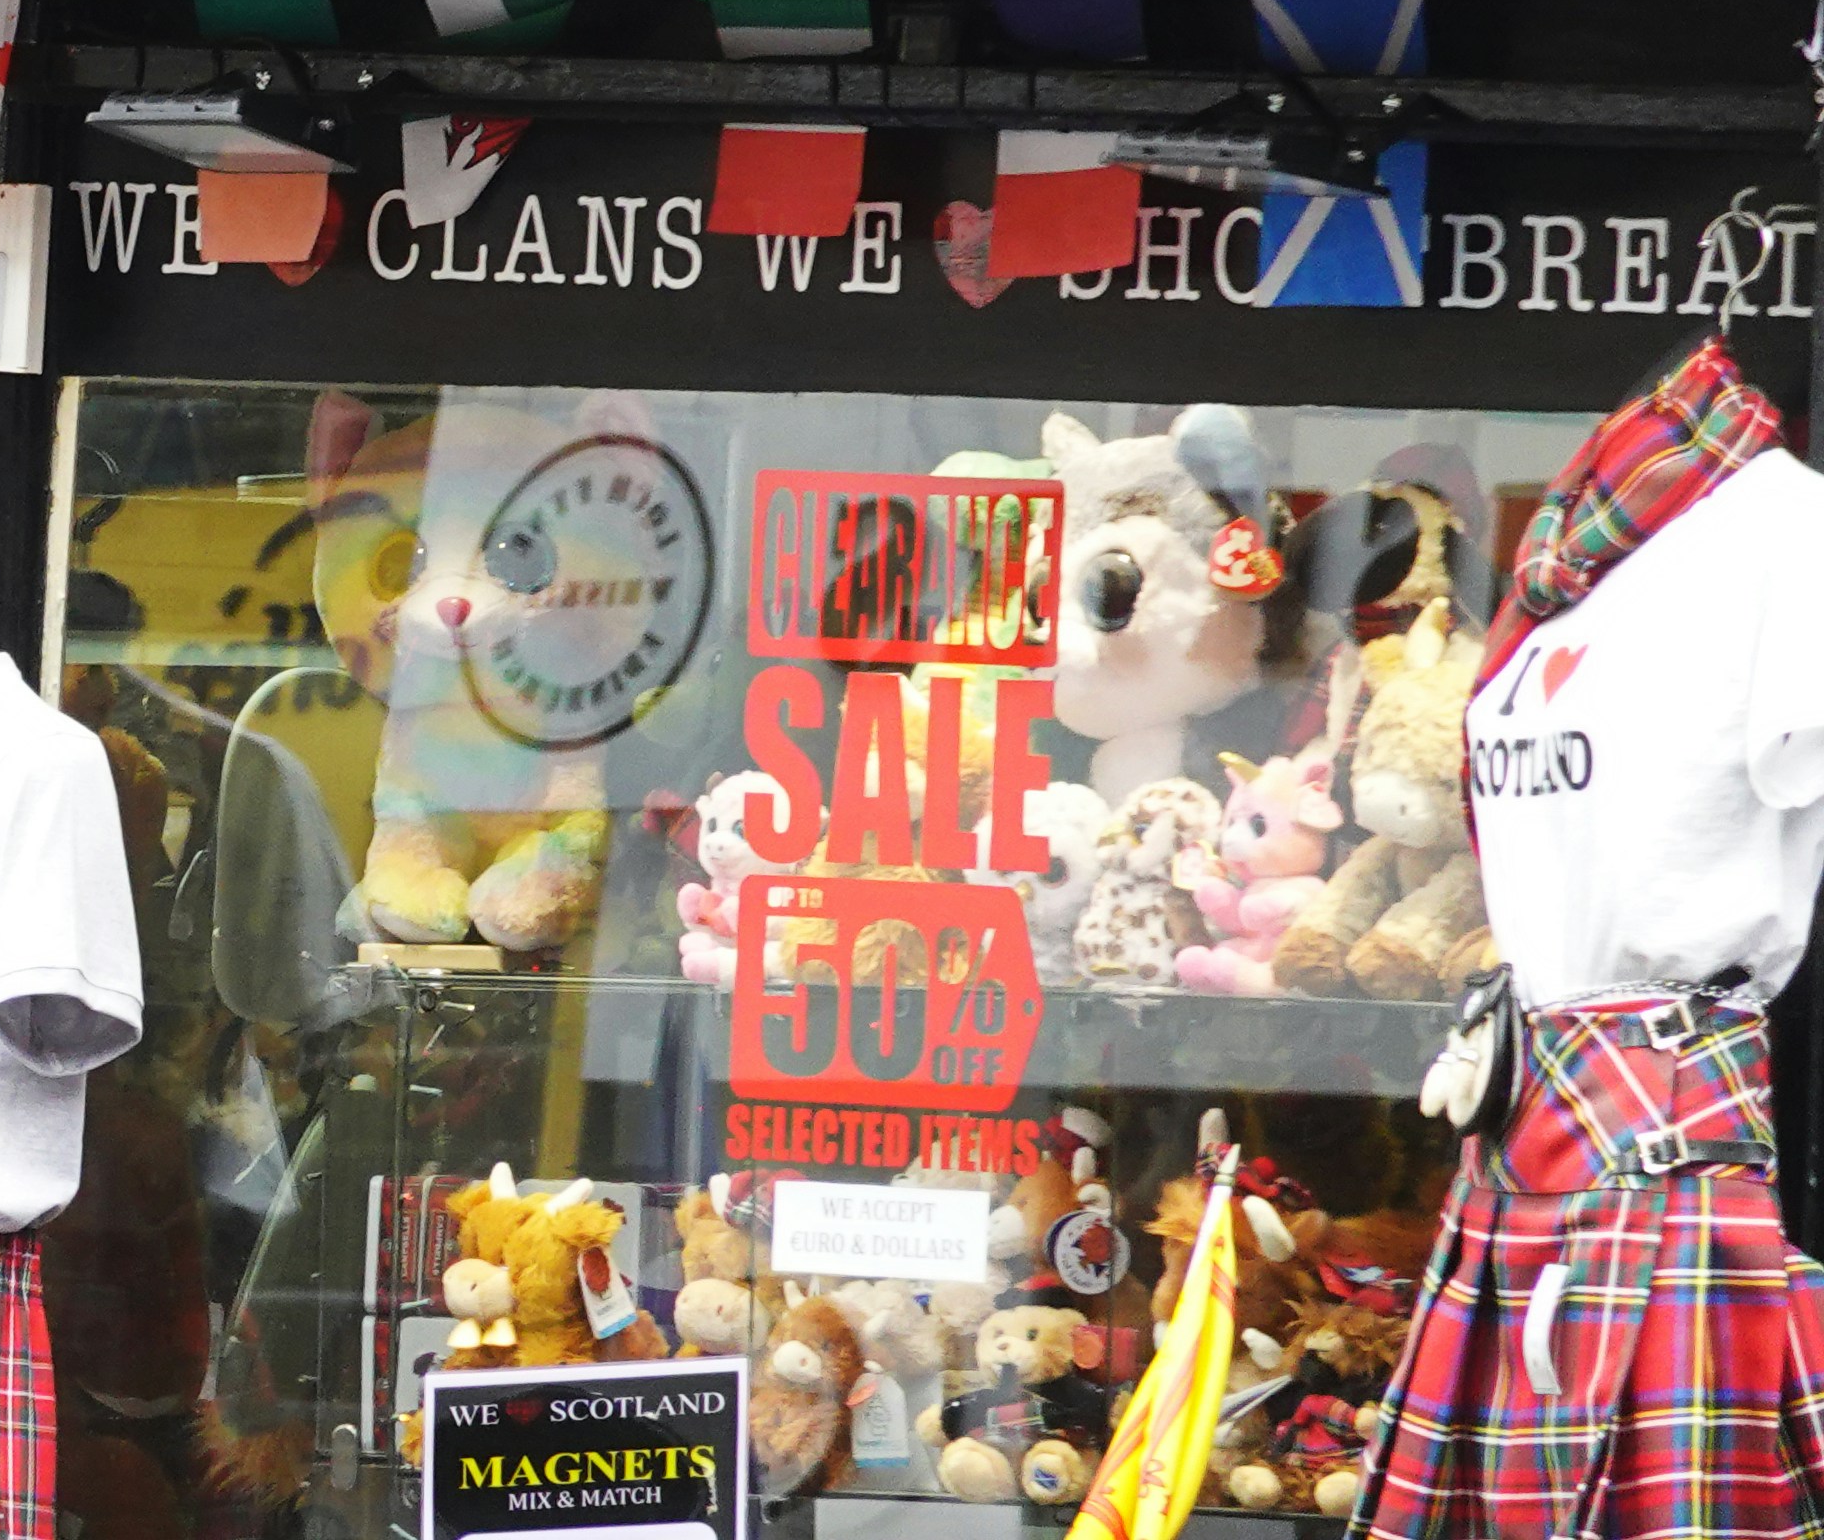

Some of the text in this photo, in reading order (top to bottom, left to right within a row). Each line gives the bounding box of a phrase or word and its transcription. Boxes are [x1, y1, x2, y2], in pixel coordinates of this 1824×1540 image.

[68, 182, 219, 276] WE
[366, 188, 705, 289] CLANS
[757, 201, 903, 294] WE
[763, 486, 1054, 649] CLEARANCE
[744, 666, 1054, 873] SALE
[1471, 731, 1593, 798] COTLAND
[766, 886, 824, 909] UP TO
[761, 915, 1008, 1081] 50%
[932, 1045, 1004, 1087] OFF
[725, 1103, 1041, 1177] SELECTED ITEMS
[821, 1196, 937, 1225] WE ACCEPT
[790, 1230, 967, 1262] €URO & DOLLARS
[450, 1391, 726, 1427] WE SCOTLAND
[458, 1445, 716, 1490] MAGNETS
[507, 1485, 662, 1512] MIX & MATCH
